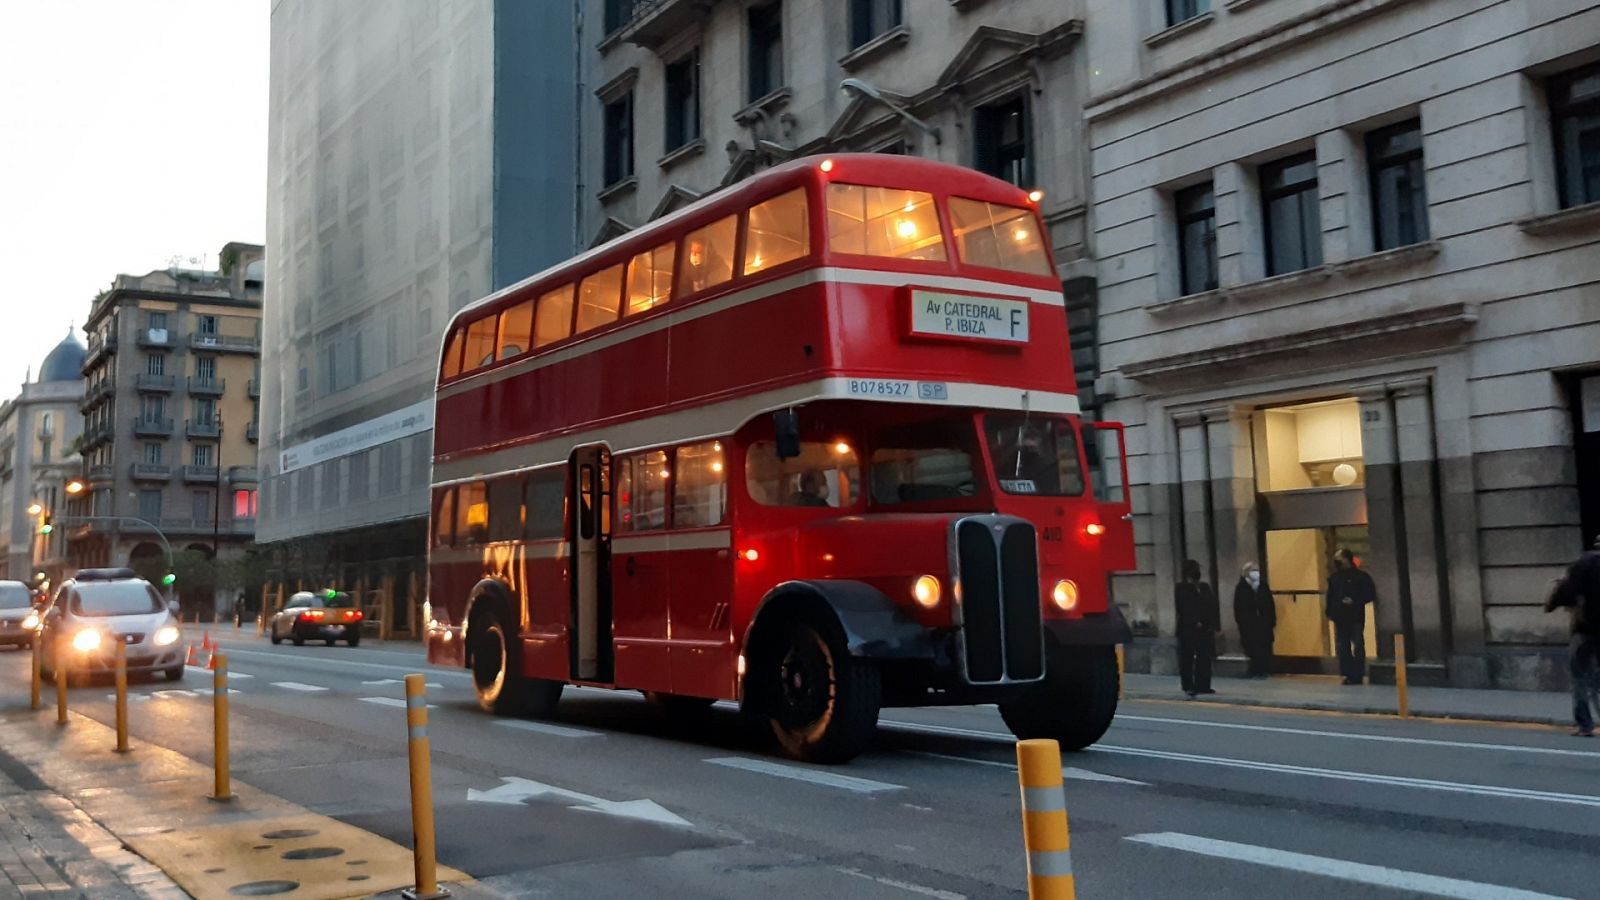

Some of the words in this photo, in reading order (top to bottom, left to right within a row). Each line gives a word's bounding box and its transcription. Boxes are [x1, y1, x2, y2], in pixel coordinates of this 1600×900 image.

[926, 299, 941, 315] Av
[944, 300, 1003, 321] CATEDRAL
[945, 317, 954, 332] P.
[957, 318, 986, 335] IBIZA
[1009, 309, 1022, 337] F
[851, 380, 909, 396] B078527
[922, 383, 943, 397] SP
